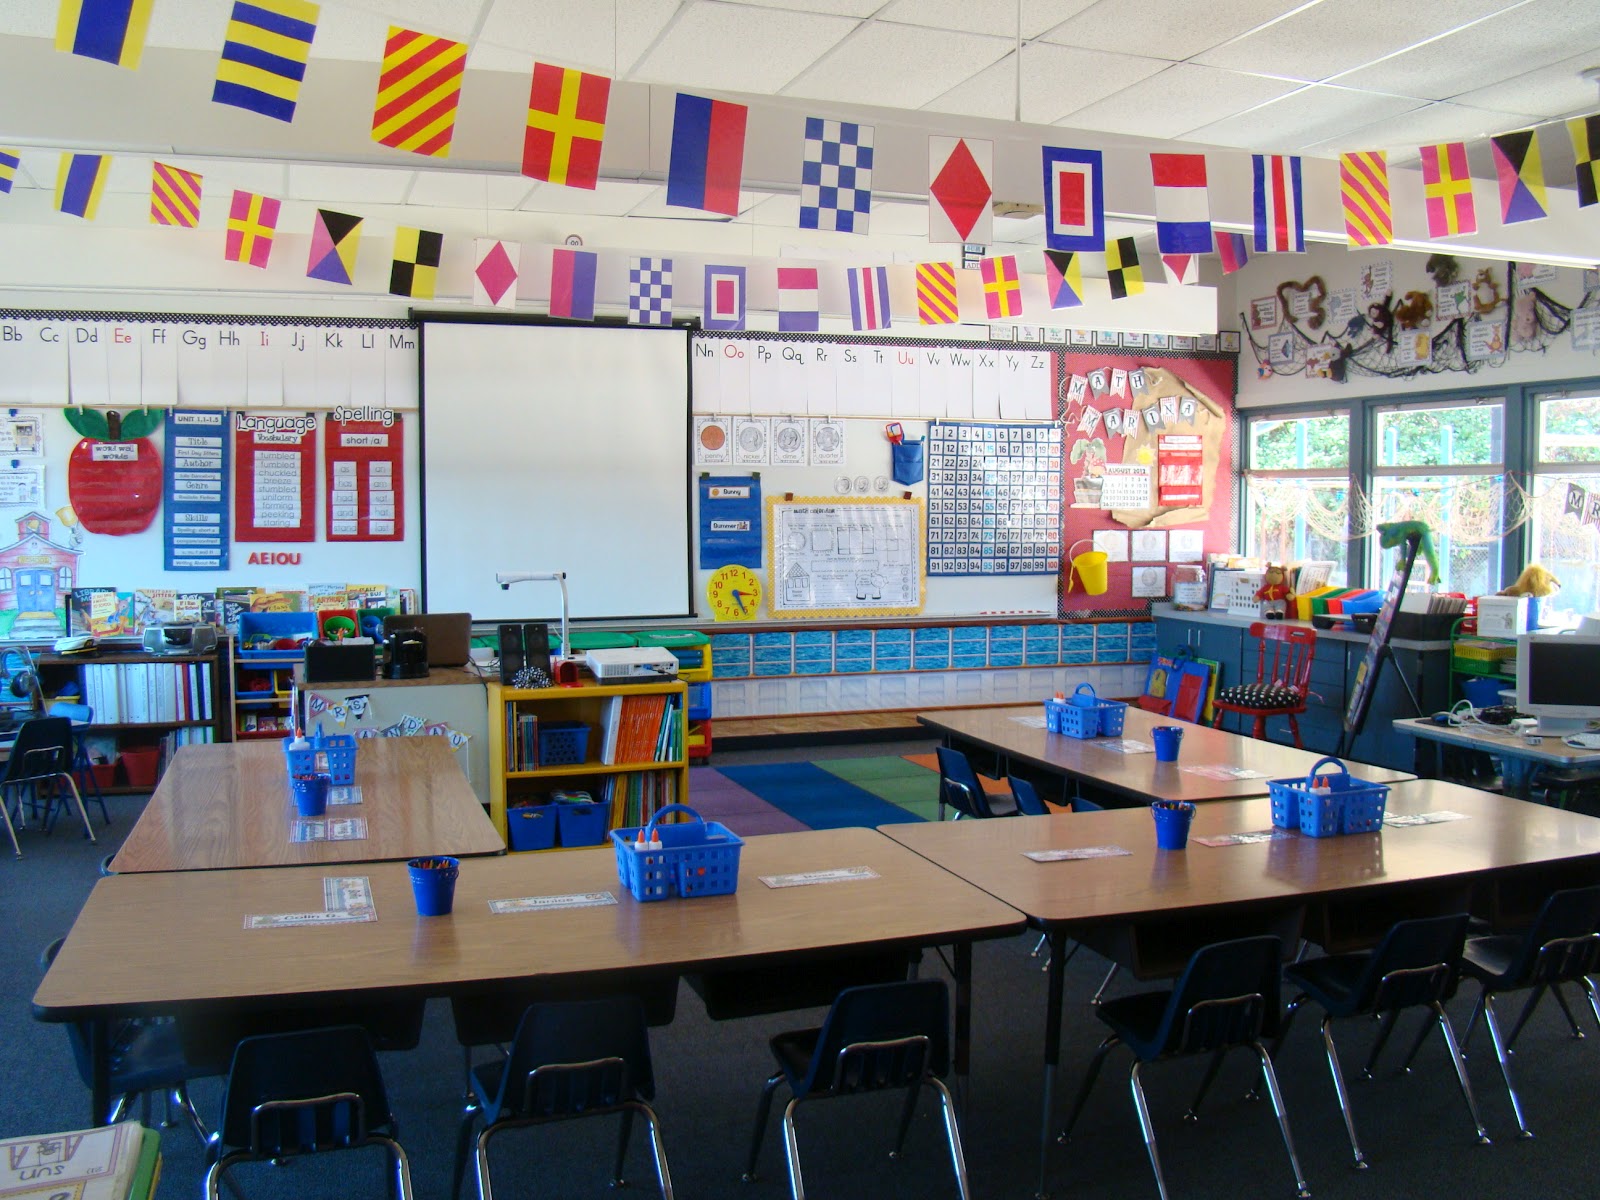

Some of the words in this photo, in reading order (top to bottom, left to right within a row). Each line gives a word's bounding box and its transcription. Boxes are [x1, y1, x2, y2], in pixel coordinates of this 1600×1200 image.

[3, 326, 22, 341] Bb
[40, 327, 59, 342] Cc
[76, 328, 98, 343] Dd
[115, 328, 131, 343] Ee
[153, 329, 166, 343] Ff
[182, 330, 206, 350] Gg
[220, 331, 239, 345] Hh
[261, 331, 268, 346] Ii
[292, 332, 304, 351] Jj
[326, 333, 342, 347] Kk
[390, 334, 415, 349] Mm
[696, 343, 713, 357] Nn
[724, 345, 744, 358] Oo
[758, 346, 771, 363] Pp
[782, 347, 804, 365] Qq
[817, 348, 827, 361] Rr
[845, 349, 856, 362] Ss
[874, 350, 883, 363] Tt
[898, 351, 913, 364] Uu
[927, 352, 940, 365] Vv
[950, 353, 970, 366] Ww
[979, 354, 994, 367] Xx
[1006, 355, 1019, 371] Yy
[1031, 356, 1044, 368] Zz
[1073, 375, 1142, 395] MATH
[335, 405, 393, 426] Spelling
[1085, 403, 1191, 428] MARINA
[238, 415, 315, 434] Language
[935, 428, 939, 437] 1
[948, 429, 953, 437] 2
[962, 430, 967, 438] 3
[975, 430, 979, 439] 4
[987, 431, 992, 439] 5
[1000, 431, 1004, 440] 6
[1013, 430, 1018, 439] 7
[1027, 431, 1031, 439] 8
[1040, 431, 1044, 440] 9
[188, 437, 208, 445] Title
[931, 502, 940, 511] 51
[944, 502, 954, 511] 52
[958, 502, 967, 511] 53
[971, 502, 981, 510] 54
[985, 502, 994, 510] 55
[998, 502, 1007, 510] 56
[930, 531, 940, 540] 71
[944, 531, 953, 540] 72
[958, 531, 967, 540] 73
[984, 531, 993, 540] 75
[997, 531, 1006, 540] 76
[1010, 531, 1020, 540] 77
[930, 546, 940, 555] 81
[944, 547, 954, 555] 82
[957, 547, 966, 555] 83
[970, 547, 980, 555] 84
[984, 547, 993, 555] 85
[997, 546, 1006, 554] 86
[1010, 546, 1020, 554] 87
[1036, 546, 1045, 554] 89
[1048, 545, 1057, 553] 90
[248, 552, 302, 565] AEIOU
[931, 562, 940, 570] 91
[944, 562, 953, 570] 92
[957, 561, 966, 570] 93
[970, 561, 980, 569] 94
[983, 561, 992, 569] 95
[996, 561, 1005, 569] 96
[1010, 561, 1019, 569] 97
[1022, 561, 1032, 569] 98
[1035, 561, 1044, 569] 99
[742, 571, 746, 579] 1
[749, 578, 754, 586] 2
[713, 591, 718, 599] 9
[717, 600, 722, 608] 8
[750, 599, 755, 607] 4
[734, 608, 739, 616] 6
